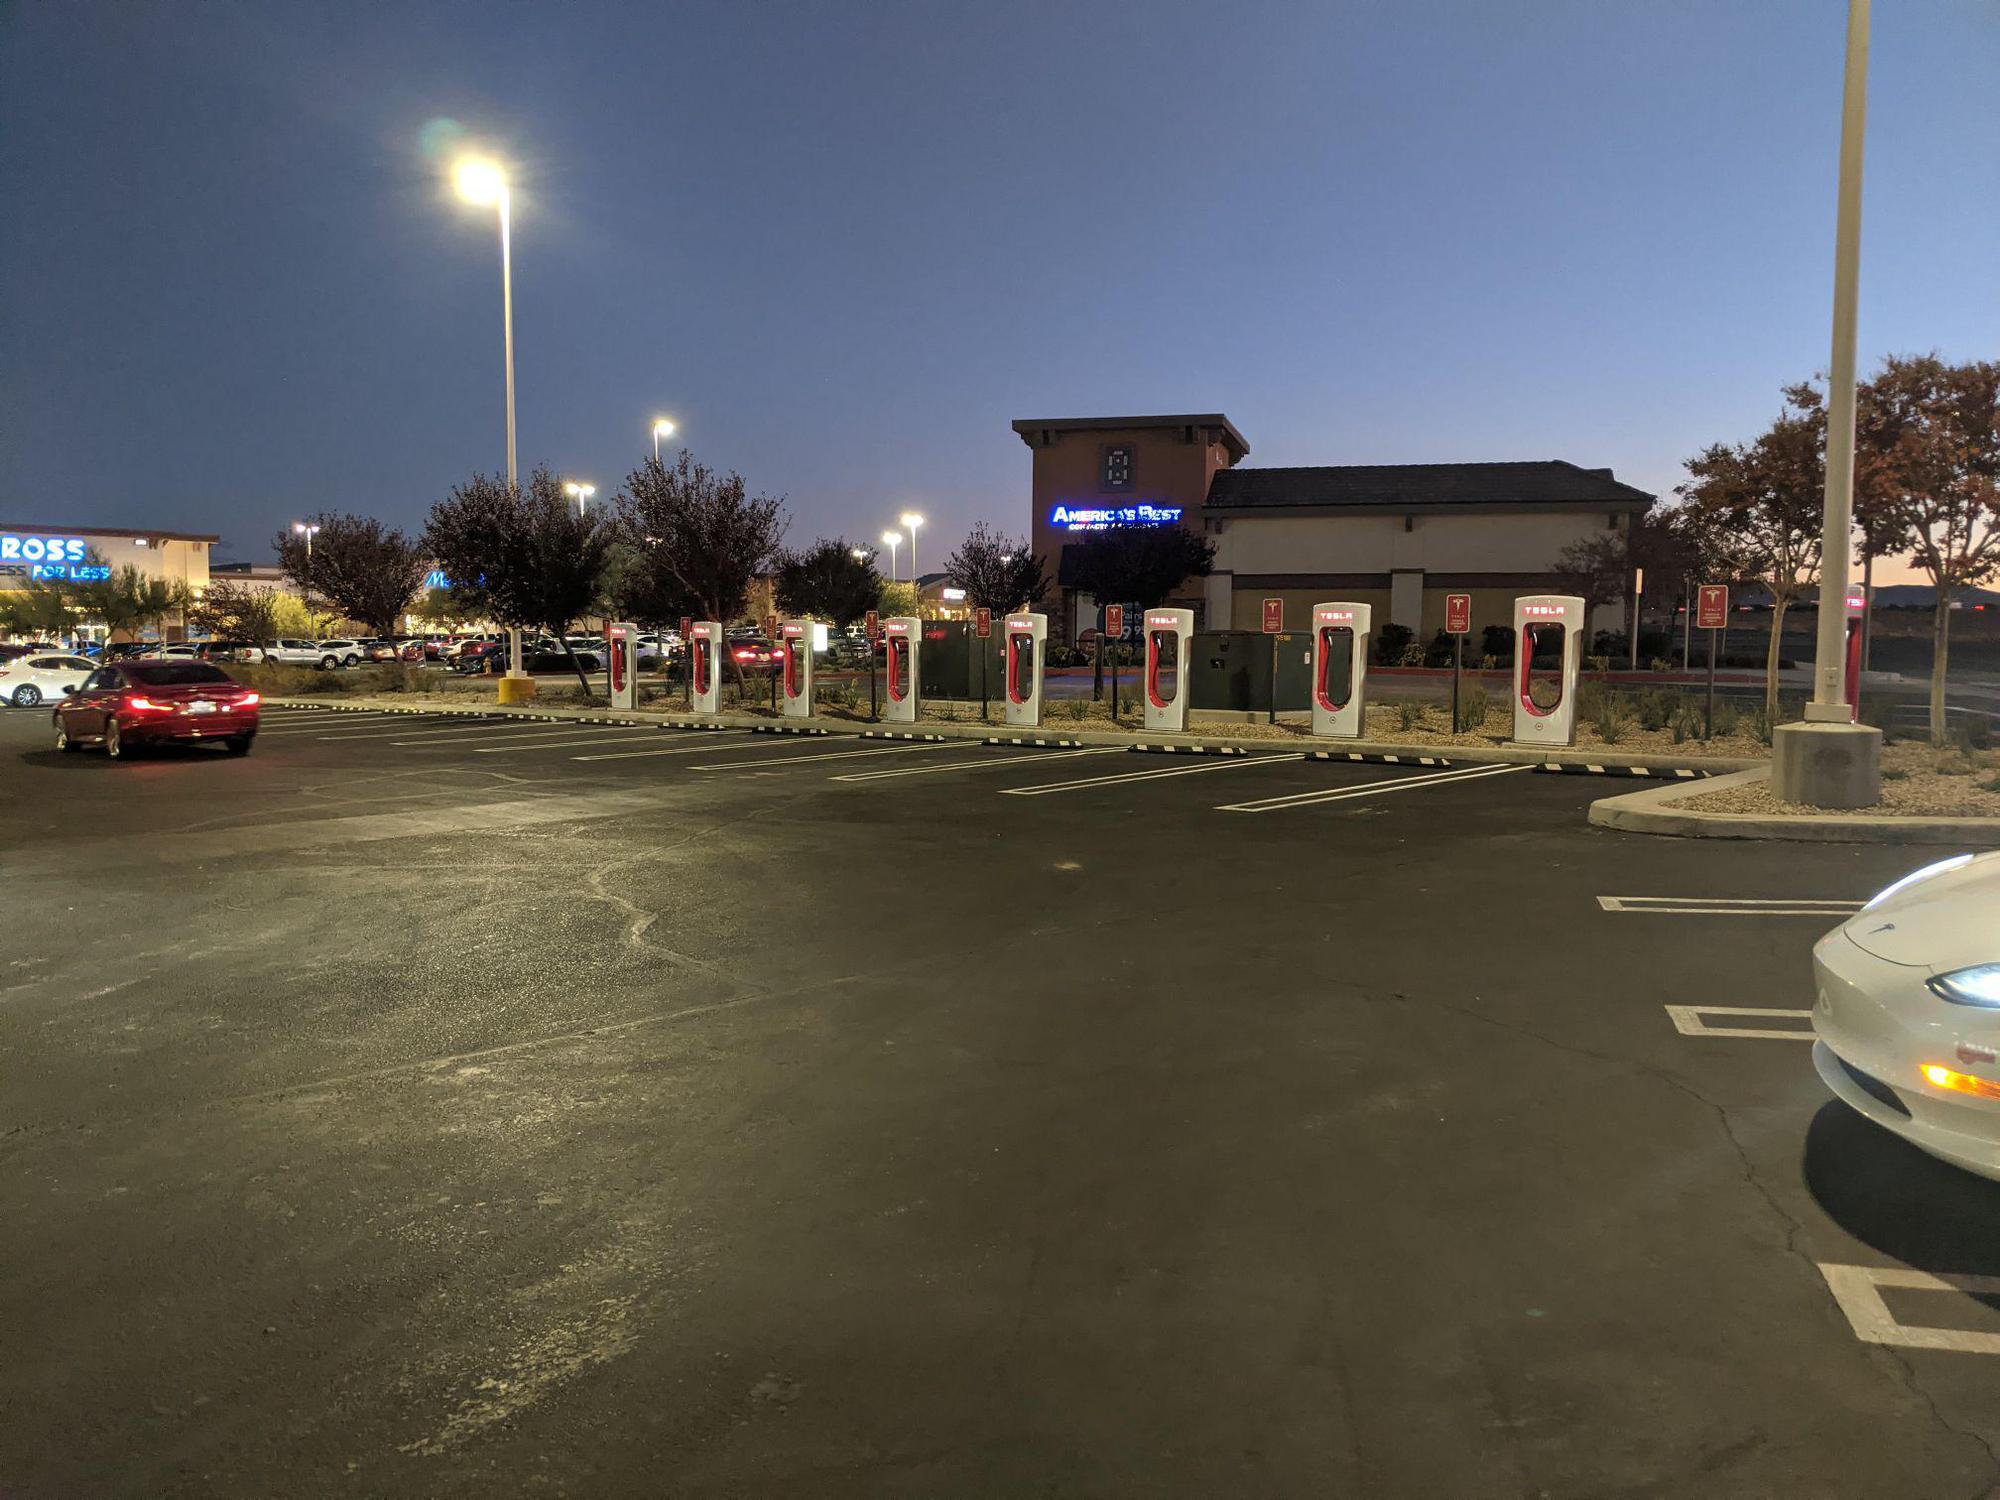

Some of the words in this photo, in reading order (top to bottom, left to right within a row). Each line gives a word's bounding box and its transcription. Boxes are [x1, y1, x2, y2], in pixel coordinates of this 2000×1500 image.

[1, 536, 84, 561] ROSS
[33, 565, 66, 580] FOR
[70, 565, 110, 580] LESS
[1525, 606, 1564, 614] TESLA
[1150, 616, 1178, 624] TESLA
[1320, 612, 1353, 620] TESLA
